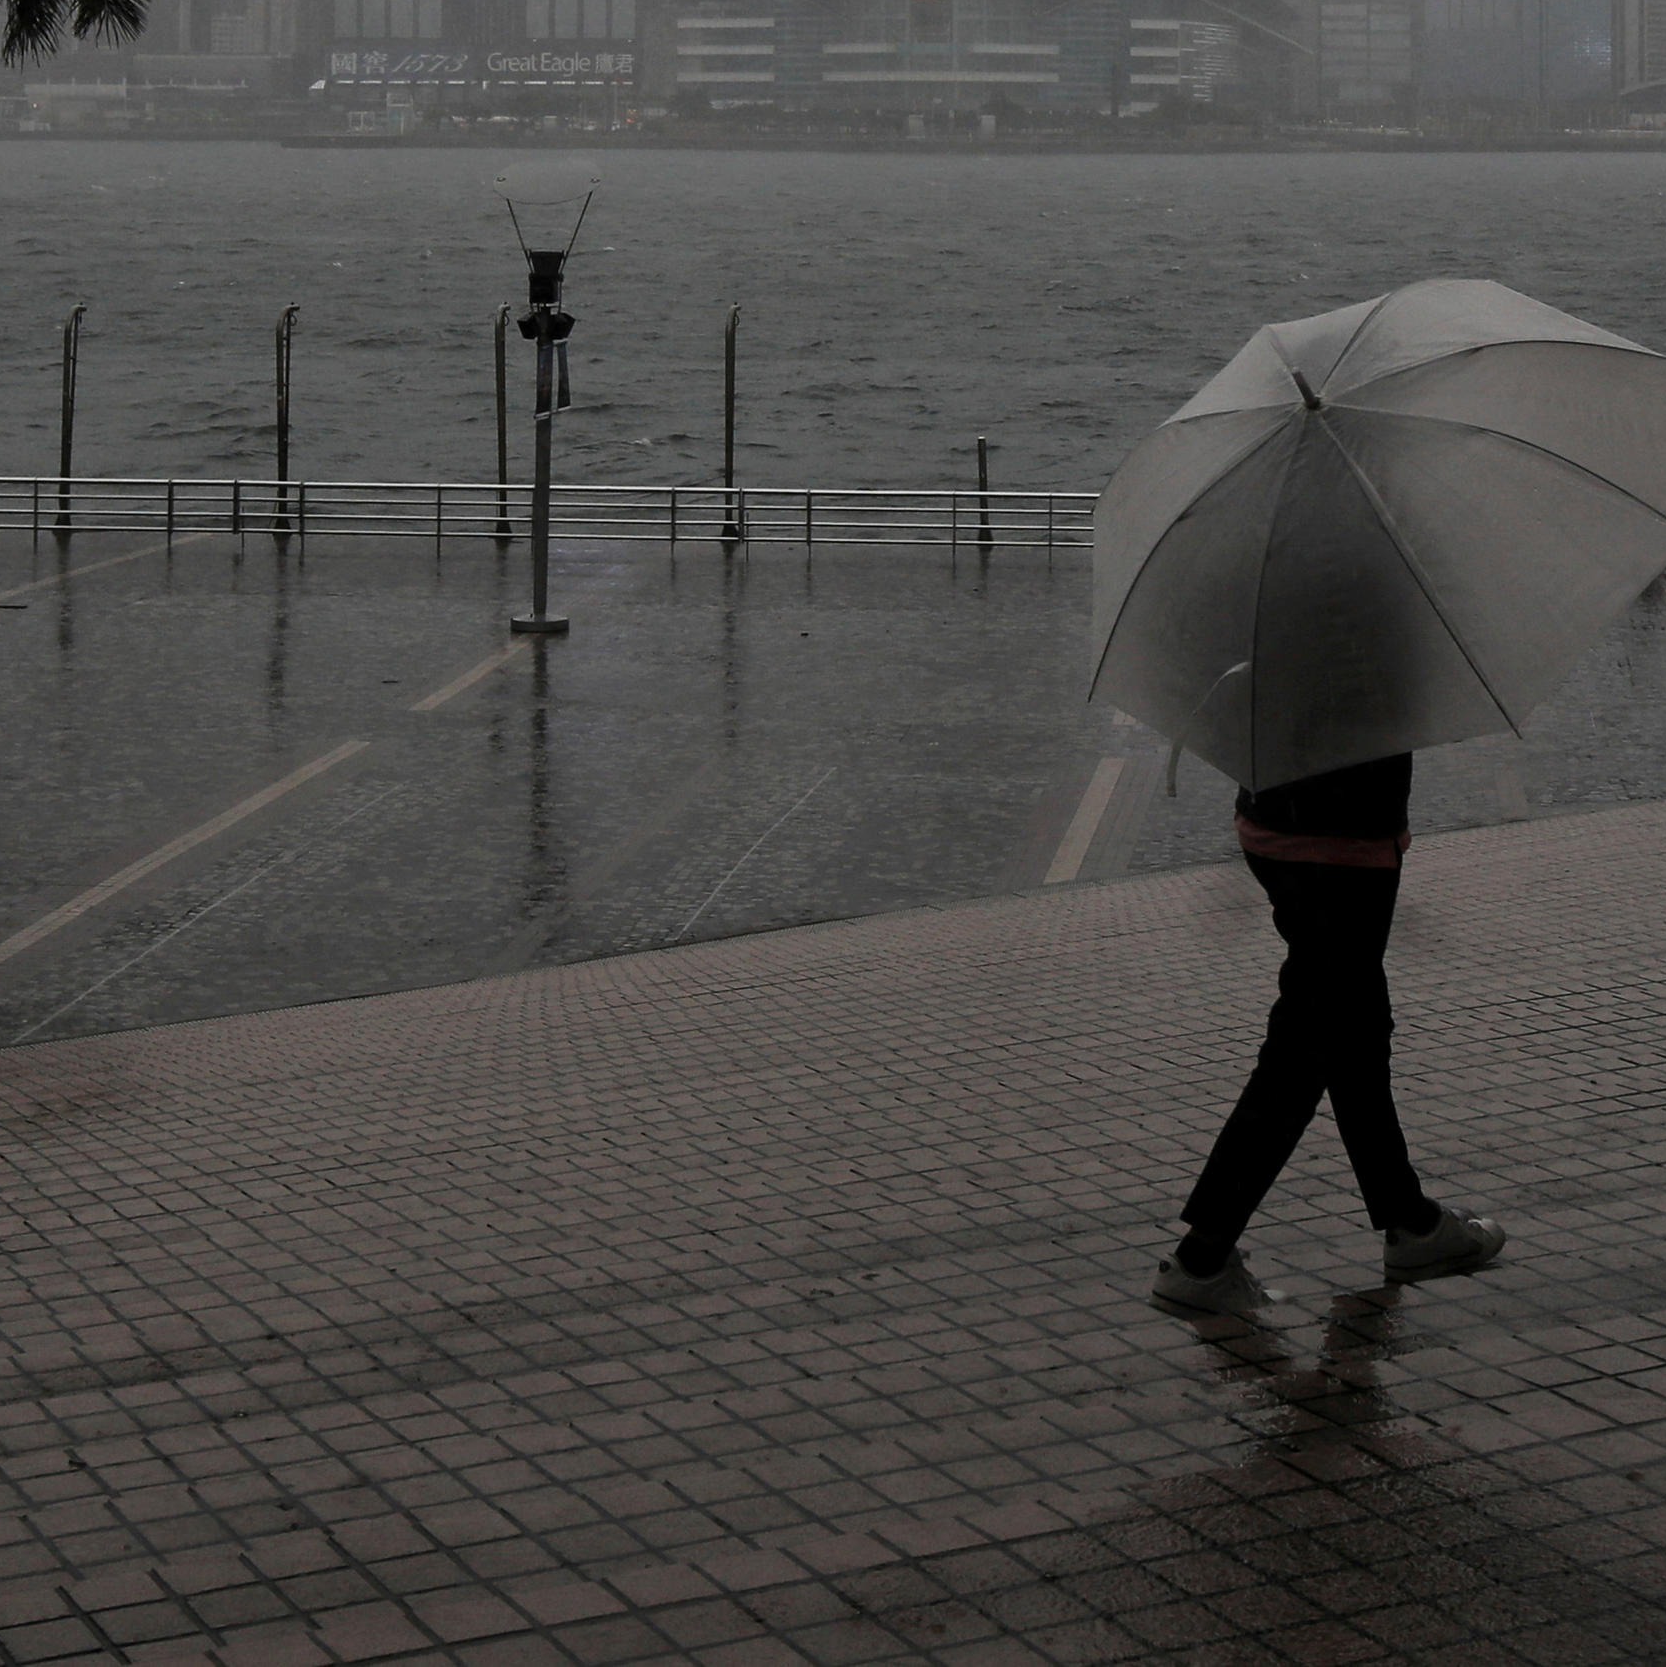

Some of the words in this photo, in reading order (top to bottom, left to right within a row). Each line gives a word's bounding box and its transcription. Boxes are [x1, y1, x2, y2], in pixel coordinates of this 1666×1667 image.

[487, 52, 538, 73] Great
[541, 53, 591, 78] Eagle
[595, 53, 634, 75] 鷹君
